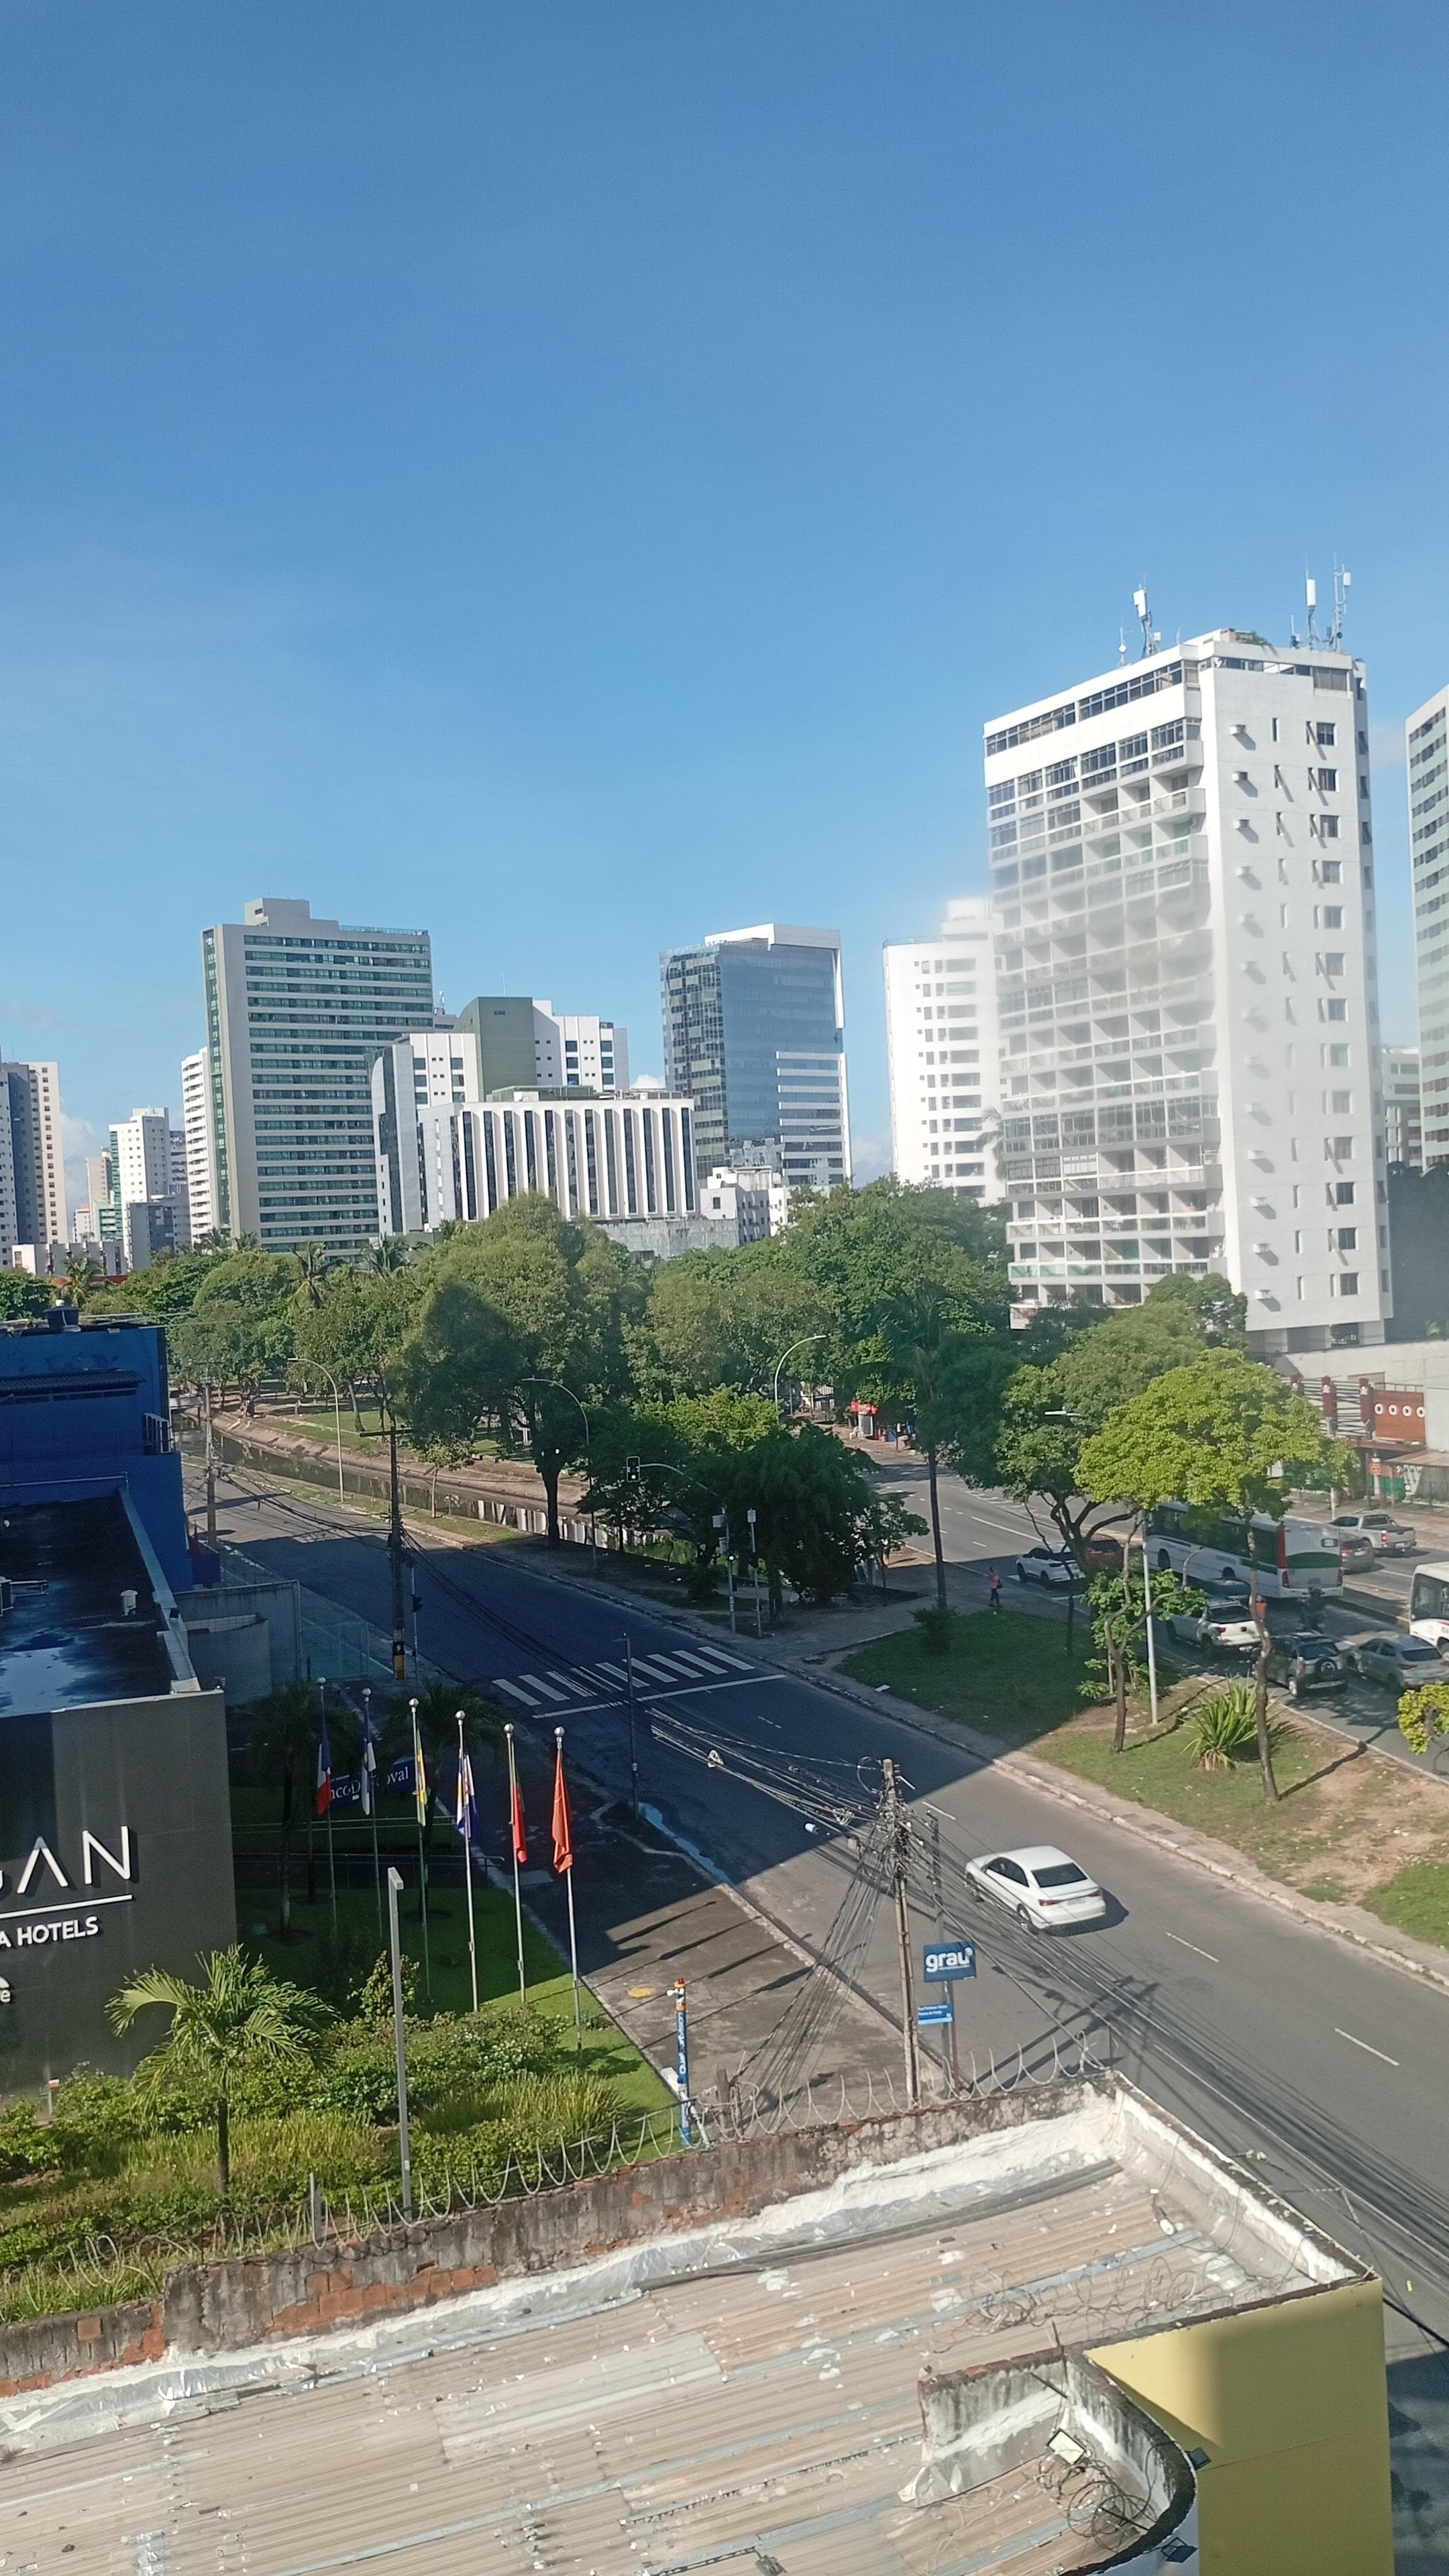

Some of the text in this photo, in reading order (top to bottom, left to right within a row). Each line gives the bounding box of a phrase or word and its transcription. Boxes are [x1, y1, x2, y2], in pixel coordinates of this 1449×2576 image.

[0, 1825, 131, 1894] AN
[17, 1916, 99, 1946] HOTELS
[925, 1947, 973, 1973] grau
